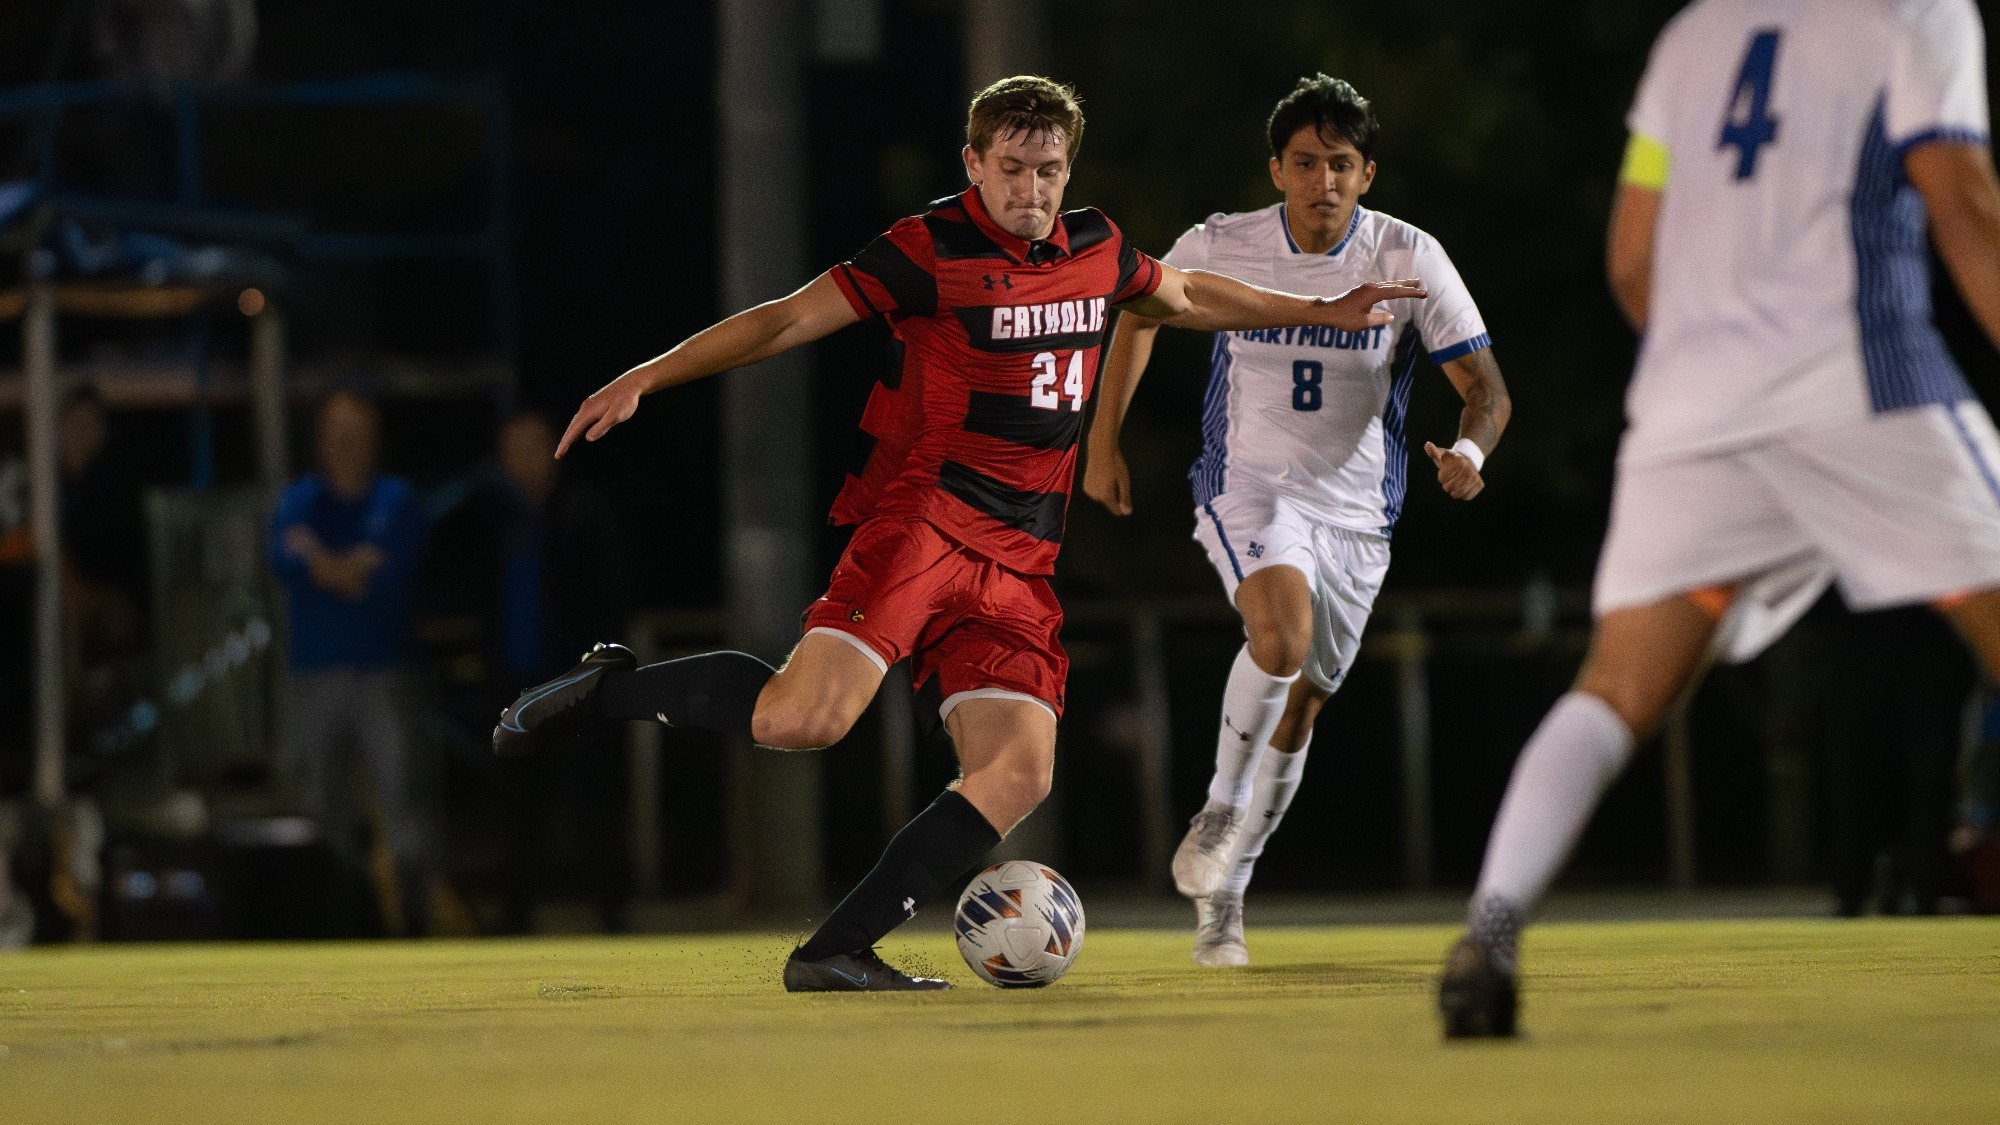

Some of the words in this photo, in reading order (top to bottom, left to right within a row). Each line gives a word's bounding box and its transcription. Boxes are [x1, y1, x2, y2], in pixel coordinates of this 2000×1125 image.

[1714, 27, 1779, 179] 4
[991, 297, 1105, 340] CATHOLIC
[1031, 350, 1083, 412] 24
[1292, 360, 1323, 411] 8
